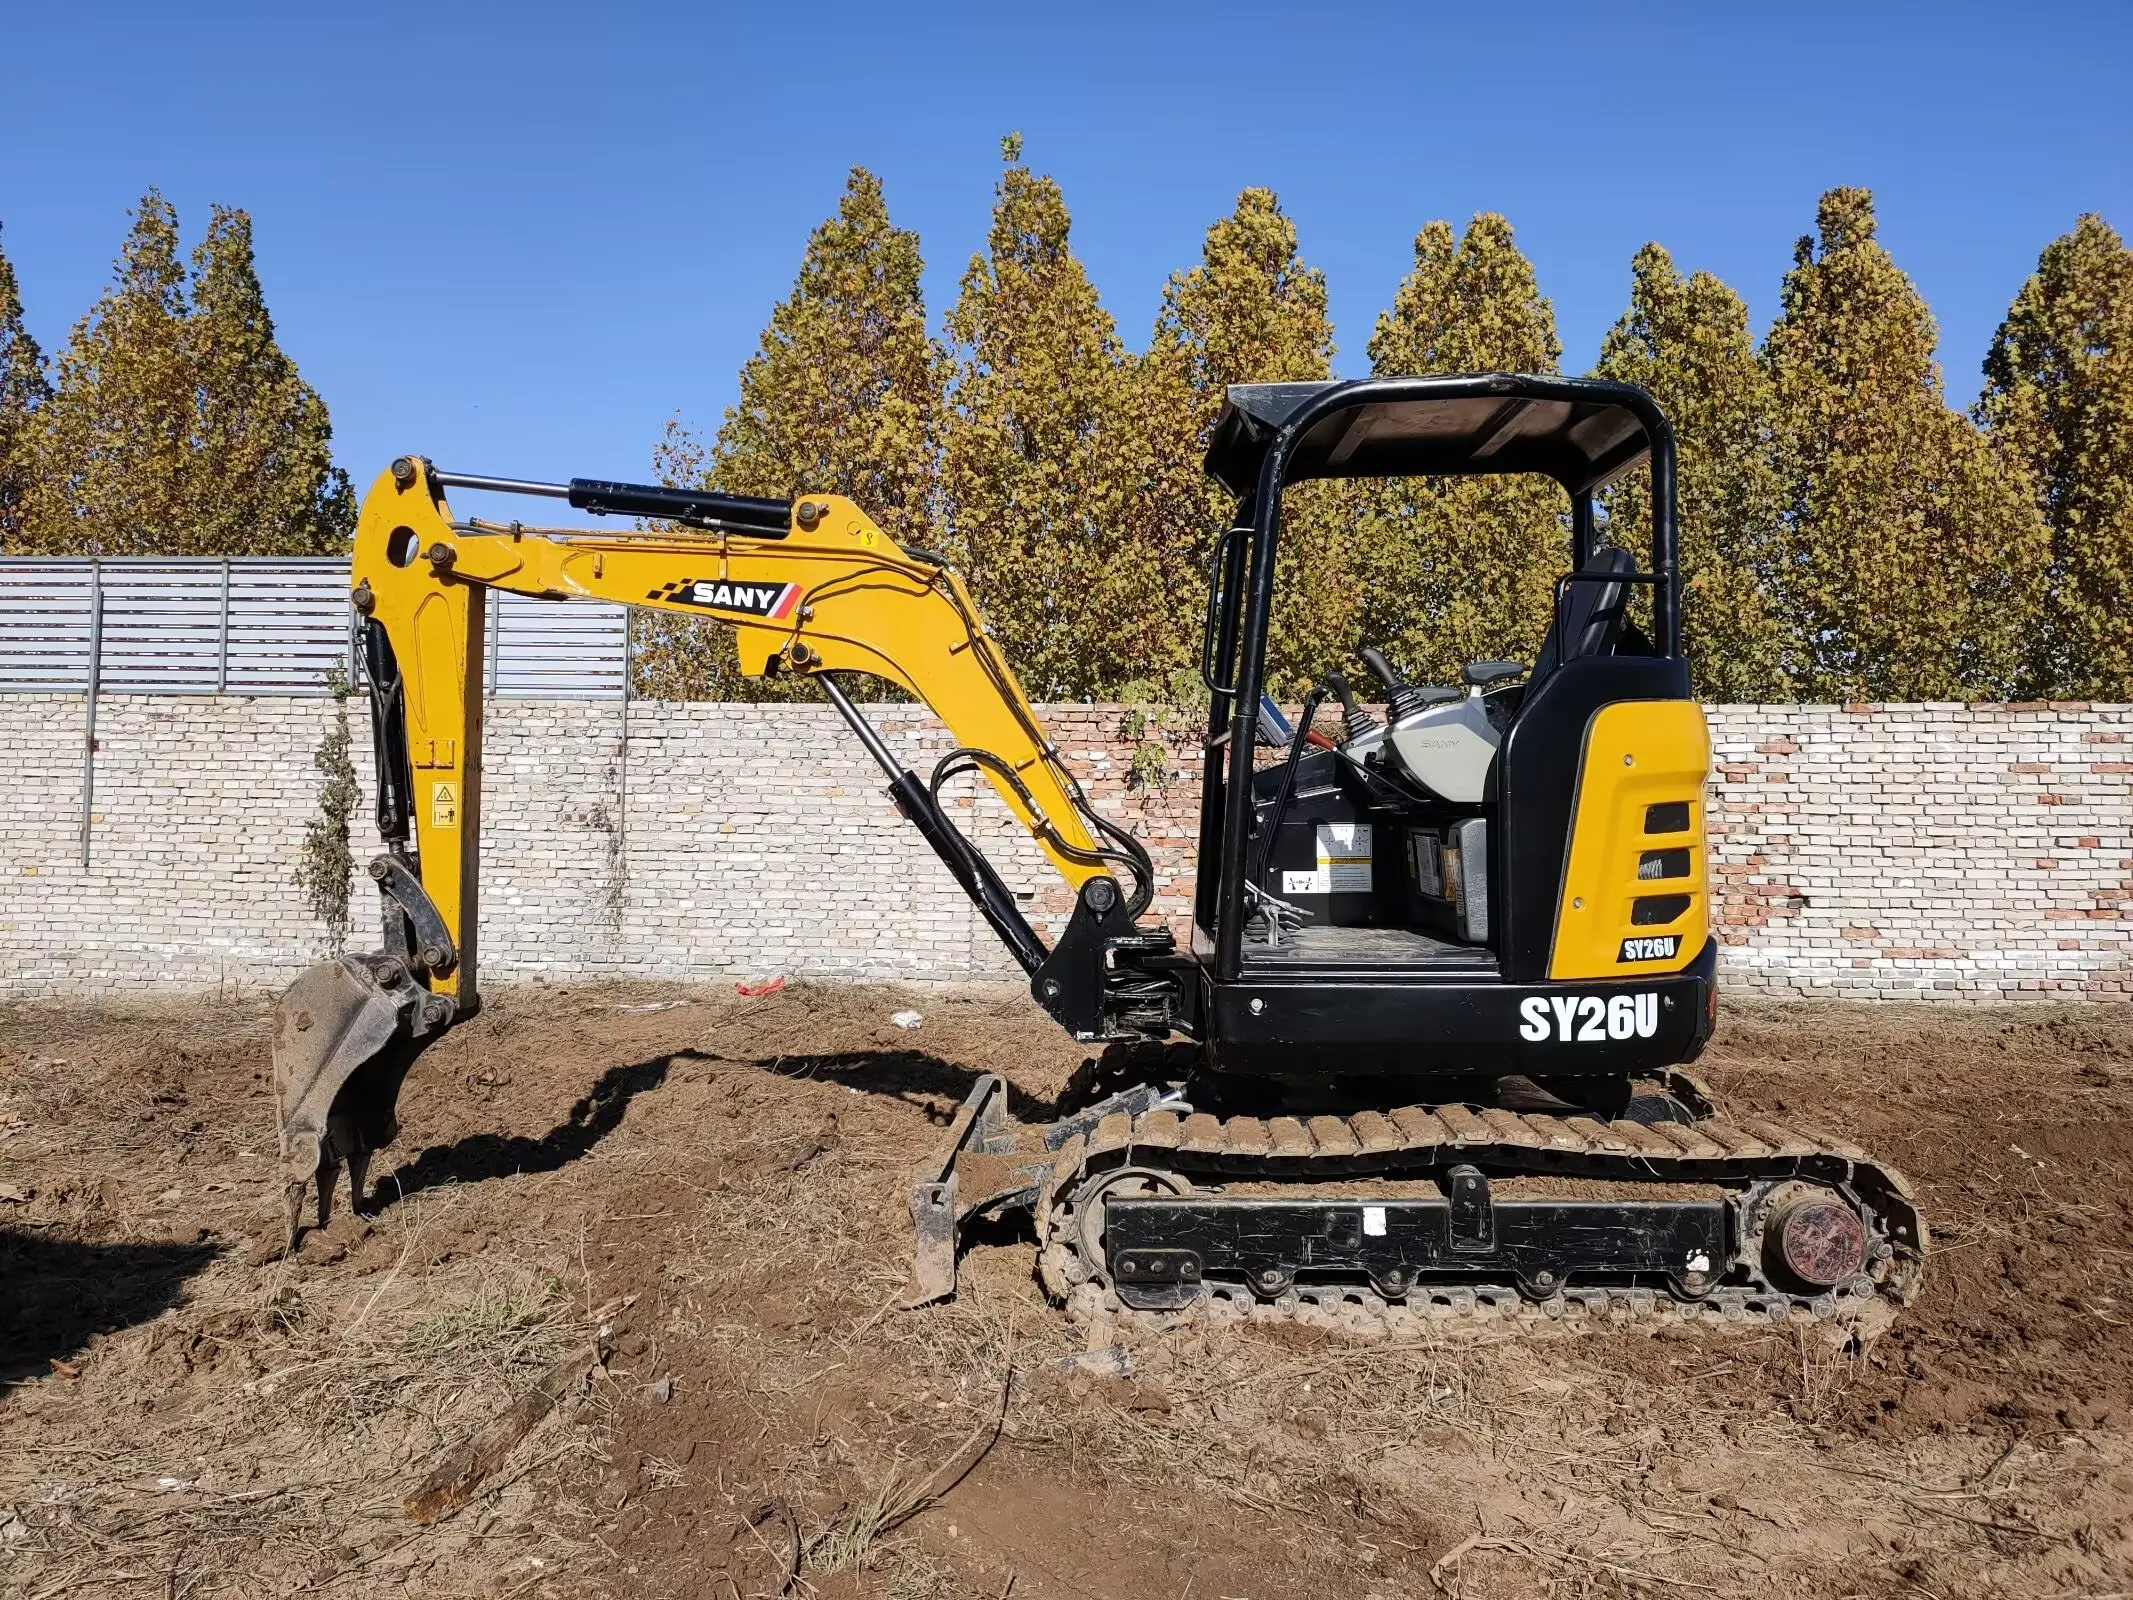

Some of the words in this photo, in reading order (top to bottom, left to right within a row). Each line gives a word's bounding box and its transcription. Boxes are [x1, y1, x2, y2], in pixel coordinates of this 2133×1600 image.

[693, 582, 776, 609] SANY
[1420, 739, 1461, 750] SANY
[1624, 937, 1675, 960] SY26U
[1519, 992, 1659, 1042] SY26U
